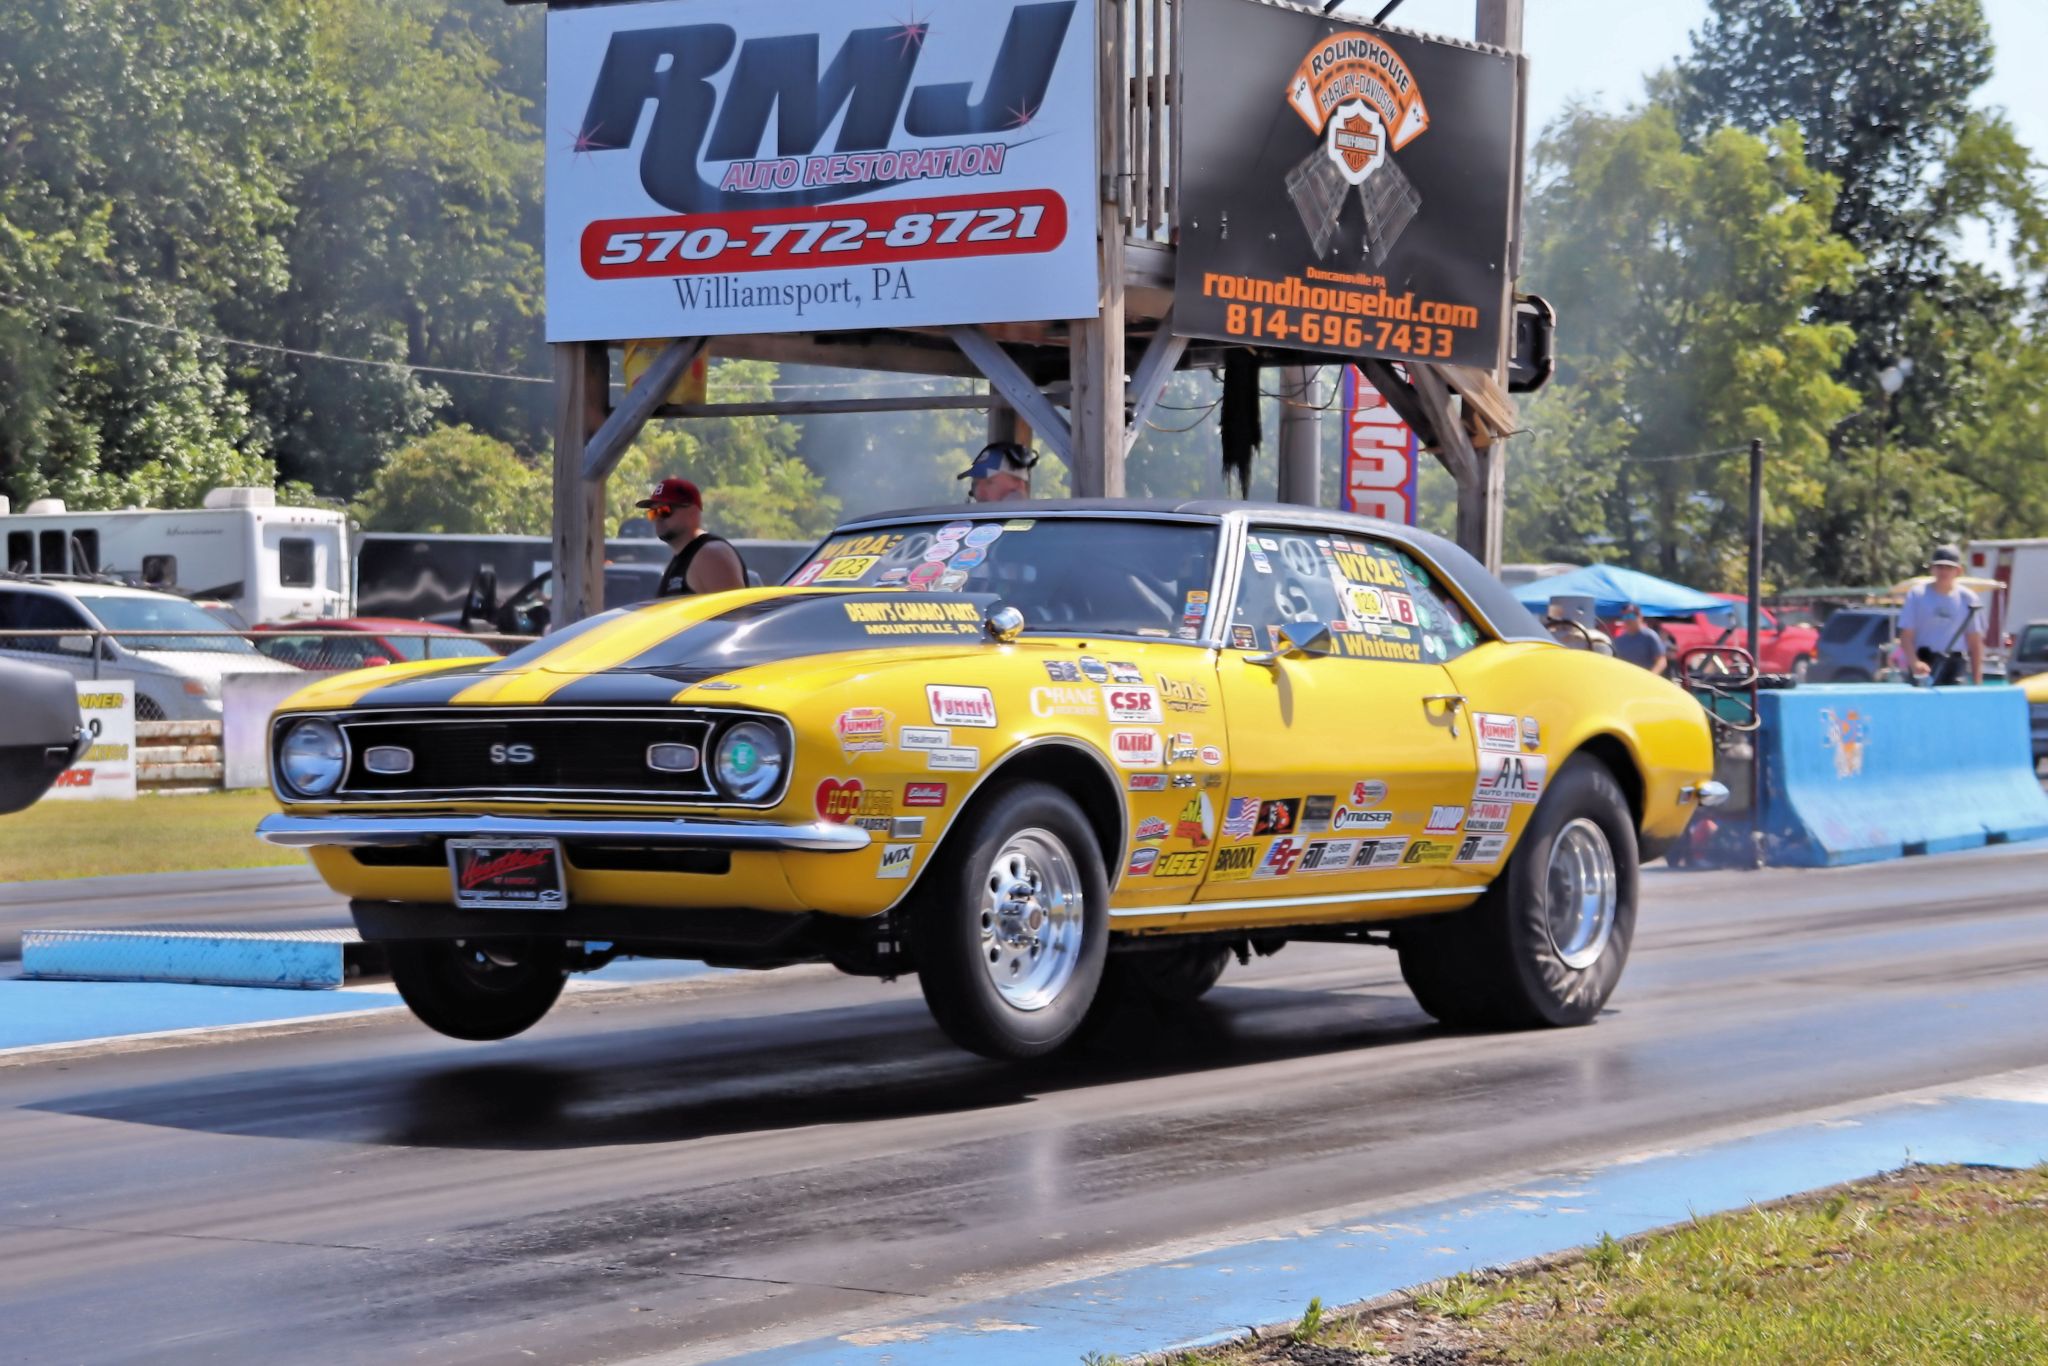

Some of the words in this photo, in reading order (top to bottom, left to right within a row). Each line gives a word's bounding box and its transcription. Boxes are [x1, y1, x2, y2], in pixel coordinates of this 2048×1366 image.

[1311, 39, 1410, 94] ROUNDHOUSE
[574, 2, 1077, 214] RMJ
[1320, 73, 1398, 123] HARLEY-DAVIDSON
[721, 161, 798, 192] AUTO
[804, 143, 1005, 187] RESTORATION
[600, 204, 1046, 266] 570-772-8721
[1306, 266, 1371, 286] Duncansville
[1372, 275, 1386, 288] PA
[674, 276, 862, 316] Williamsport,
[871, 266, 915, 301] PA
[1203, 271, 1478, 328] roundhousehd.com
[1226, 304, 1453, 358] 814-696-7433
[799, 563, 824, 585] B
[832, 559, 869, 576] 123
[943, 604, 981, 621] PARTS
[1397, 600, 1413, 623] B
[960, 625, 979, 634] PA
[1342, 634, 1421, 661] Whitmer
[1157, 673, 1208, 702] Dan's
[932, 690, 992, 719] SUMMIT
[1030, 686, 1097, 718] CRANE
[1110, 691, 1151, 711] CSR
[838, 714, 884, 734] SUMMIT
[1479, 717, 1516, 740] SUMMIT
[490, 744, 535, 763] SS
[1493, 757, 1526, 790] AA
[1478, 789, 1501, 797] AUTO
[1504, 790, 1537, 799] STORES
[1346, 812, 1392, 822] MOSER
[1466, 820, 1488, 830] RACING
[1490, 820, 1504, 830] GEAR
[882, 846, 912, 867] WIX
